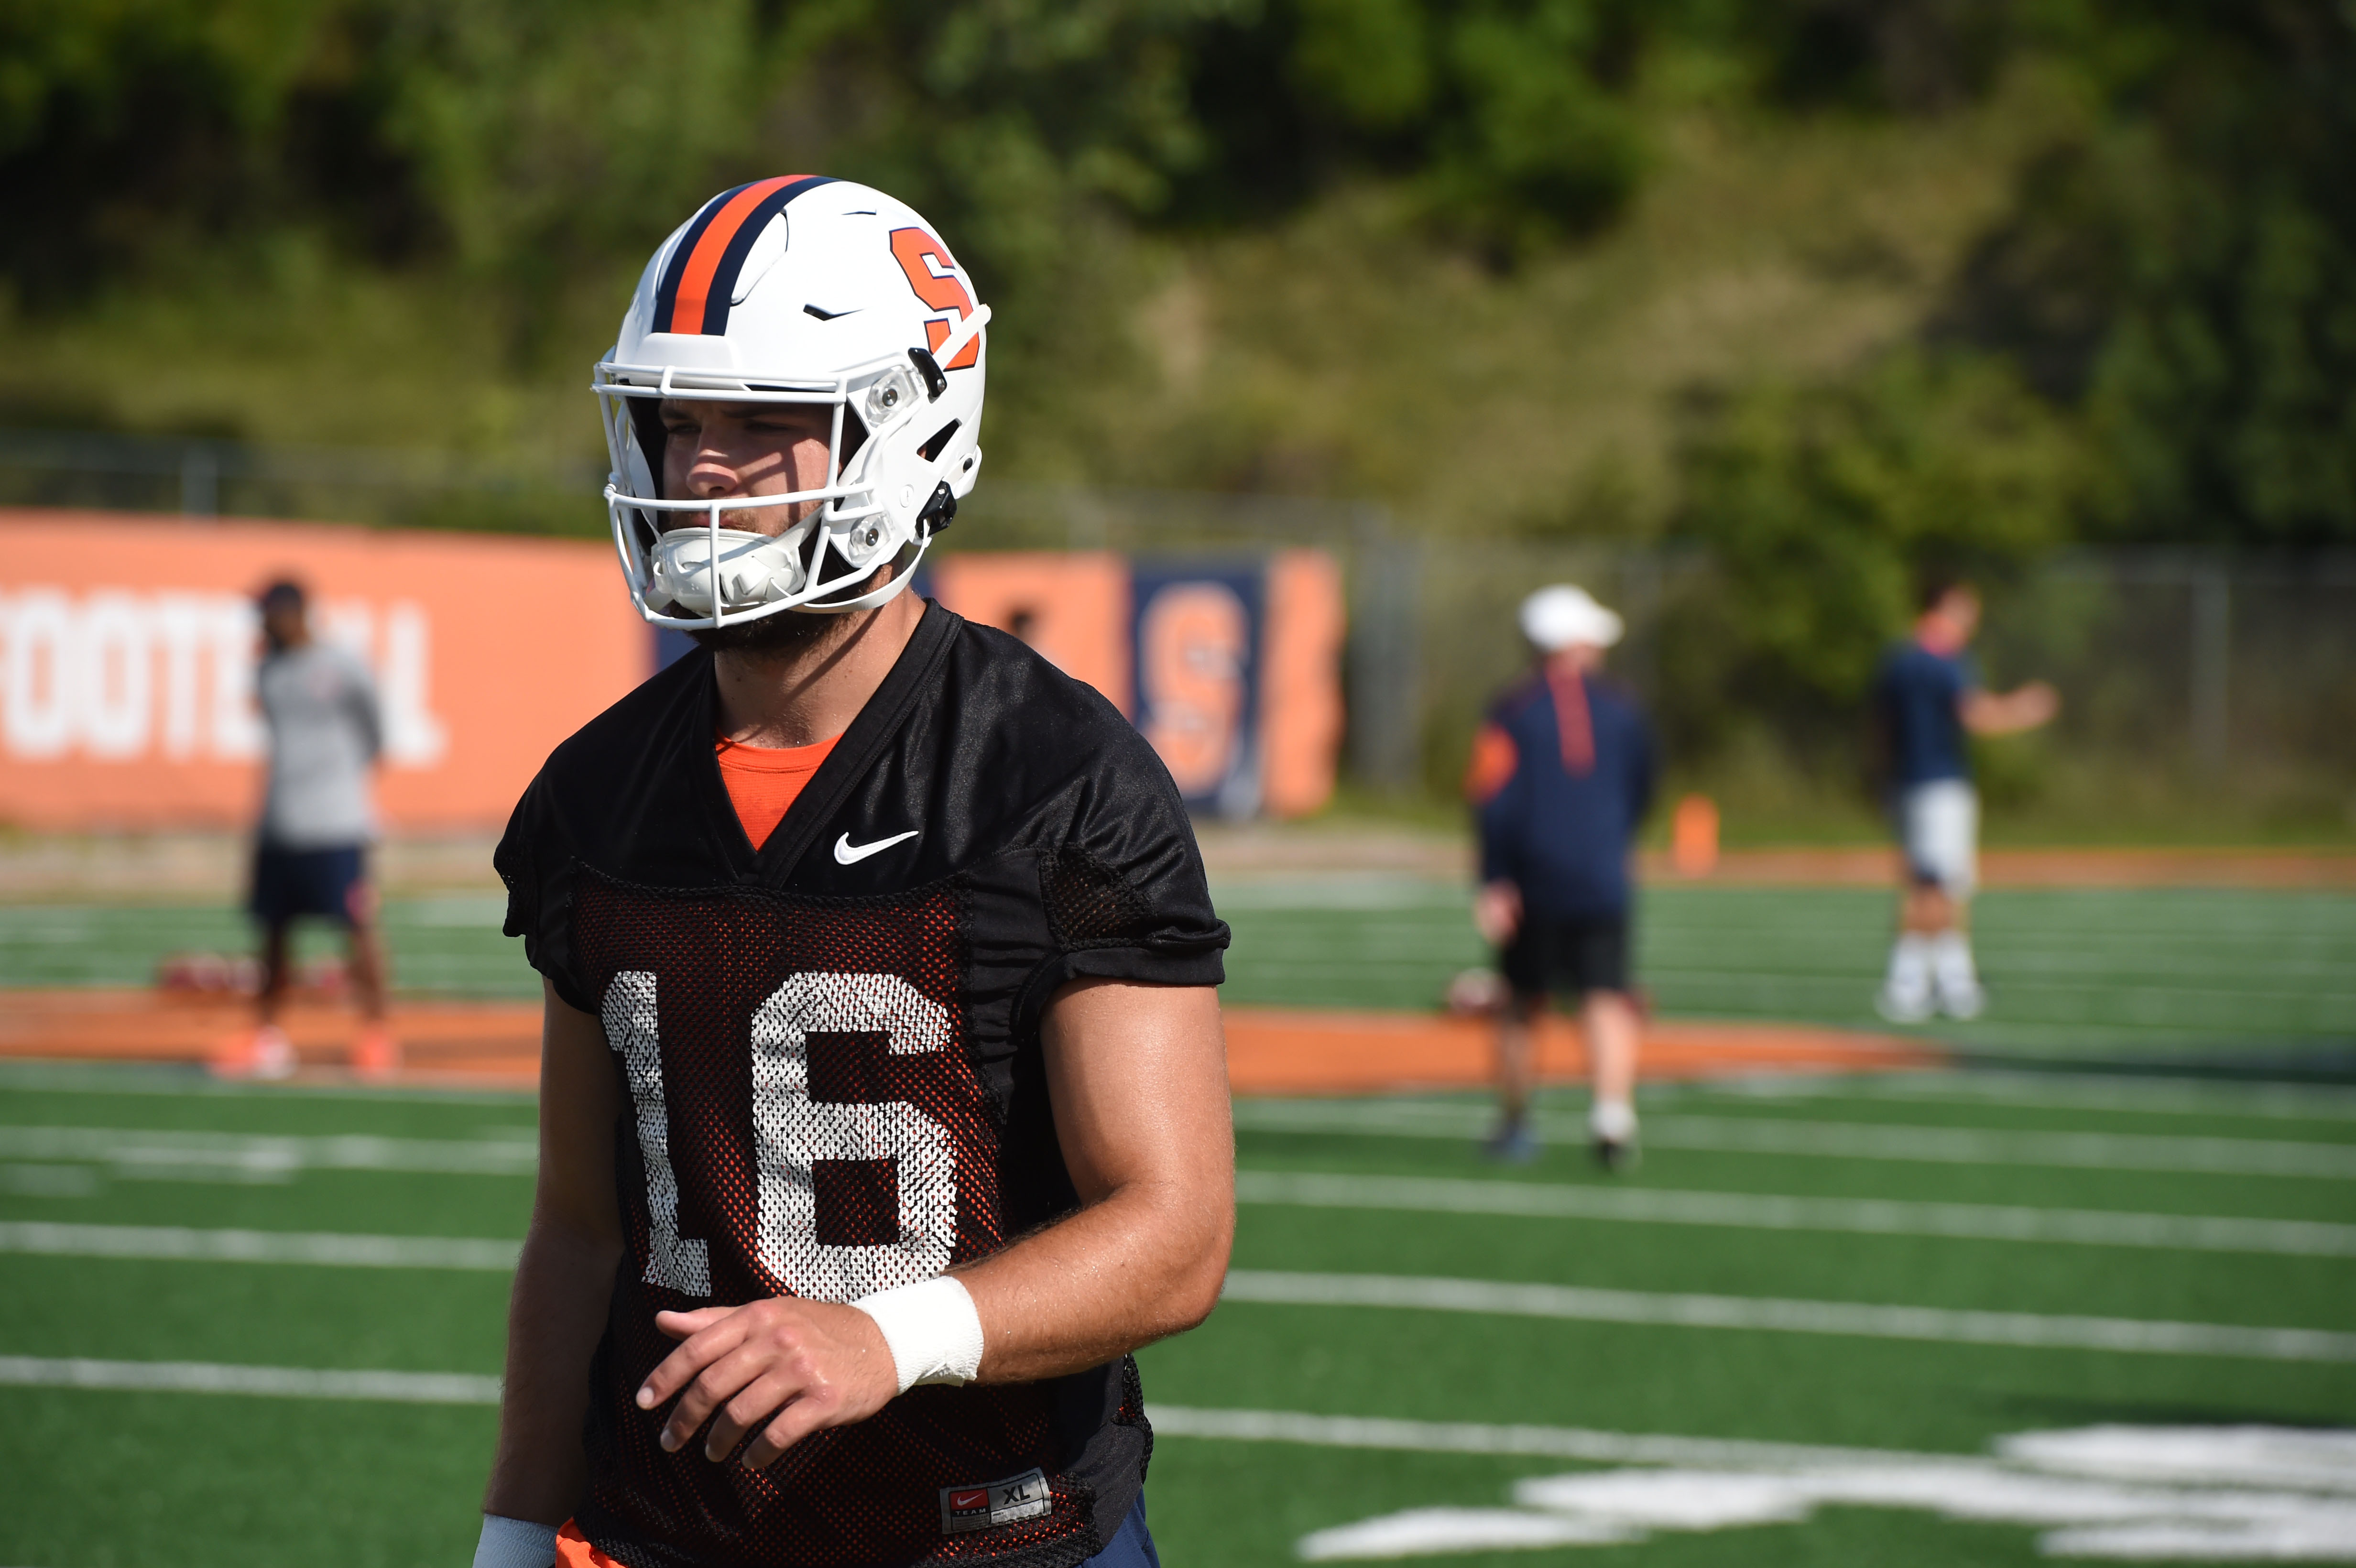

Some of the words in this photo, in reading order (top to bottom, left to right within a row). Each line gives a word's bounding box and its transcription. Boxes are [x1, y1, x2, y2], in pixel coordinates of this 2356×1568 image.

[889, 227, 980, 371] S
[1139, 582, 1249, 796] S
[601, 970, 958, 1304] 16
[1003, 1484, 1030, 1505] XL
